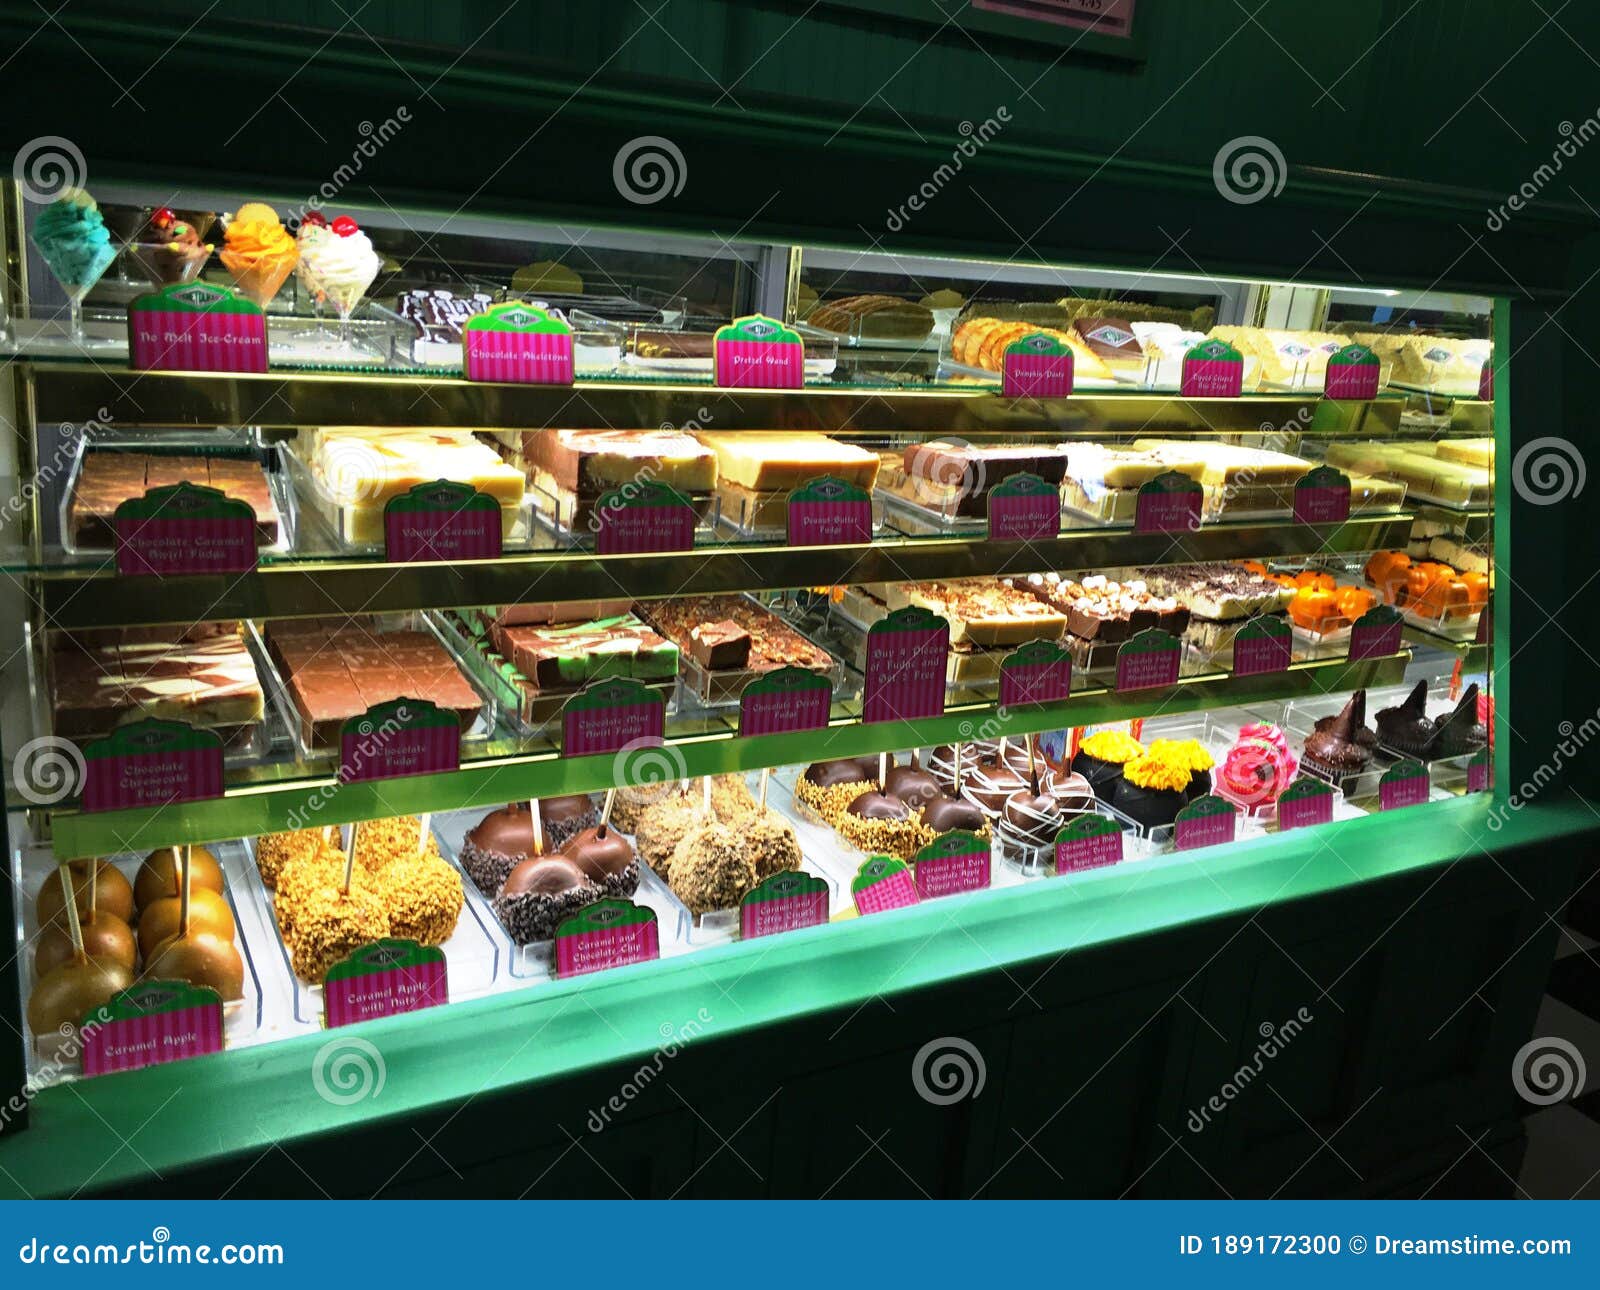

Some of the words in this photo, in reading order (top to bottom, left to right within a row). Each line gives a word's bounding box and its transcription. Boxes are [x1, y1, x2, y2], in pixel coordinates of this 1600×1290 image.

[140, 331, 158, 343] No
[199, 332, 261, 345] Ice-Cream
[472, 349, 517, 361] Chocolate
[734, 354, 762, 366] Pretzel
[765, 355, 789, 366] Wand
[442, 527, 485, 538] Caramel
[819, 525, 842, 535] Fudge
[130, 537, 187, 549] Chocolate
[195, 536, 247, 547] Caramel
[921, 656, 939, 667] and
[913, 671, 935, 681] Free
[376, 744, 425, 757] Chocolate
[385, 756, 417, 767] Fudge
[124, 762, 184, 776] Chocolate
[137, 787, 174, 800] Fudge
[952, 860, 964, 870] and
[760, 902, 793, 915] Caramel
[795, 898, 811, 907] and
[578, 935, 615, 951] Caramel
[619, 931, 636, 942] and
[573, 948, 617, 963] Chocolate
[620, 943, 641, 954] Chip
[348, 987, 392, 1004] Caramel
[397, 981, 428, 995] Apple
[361, 1001, 385, 1014] with
[391, 997, 417, 1008] Nuts
[105, 1038, 157, 1057] Caramel
[163, 1031, 198, 1047] Apple
